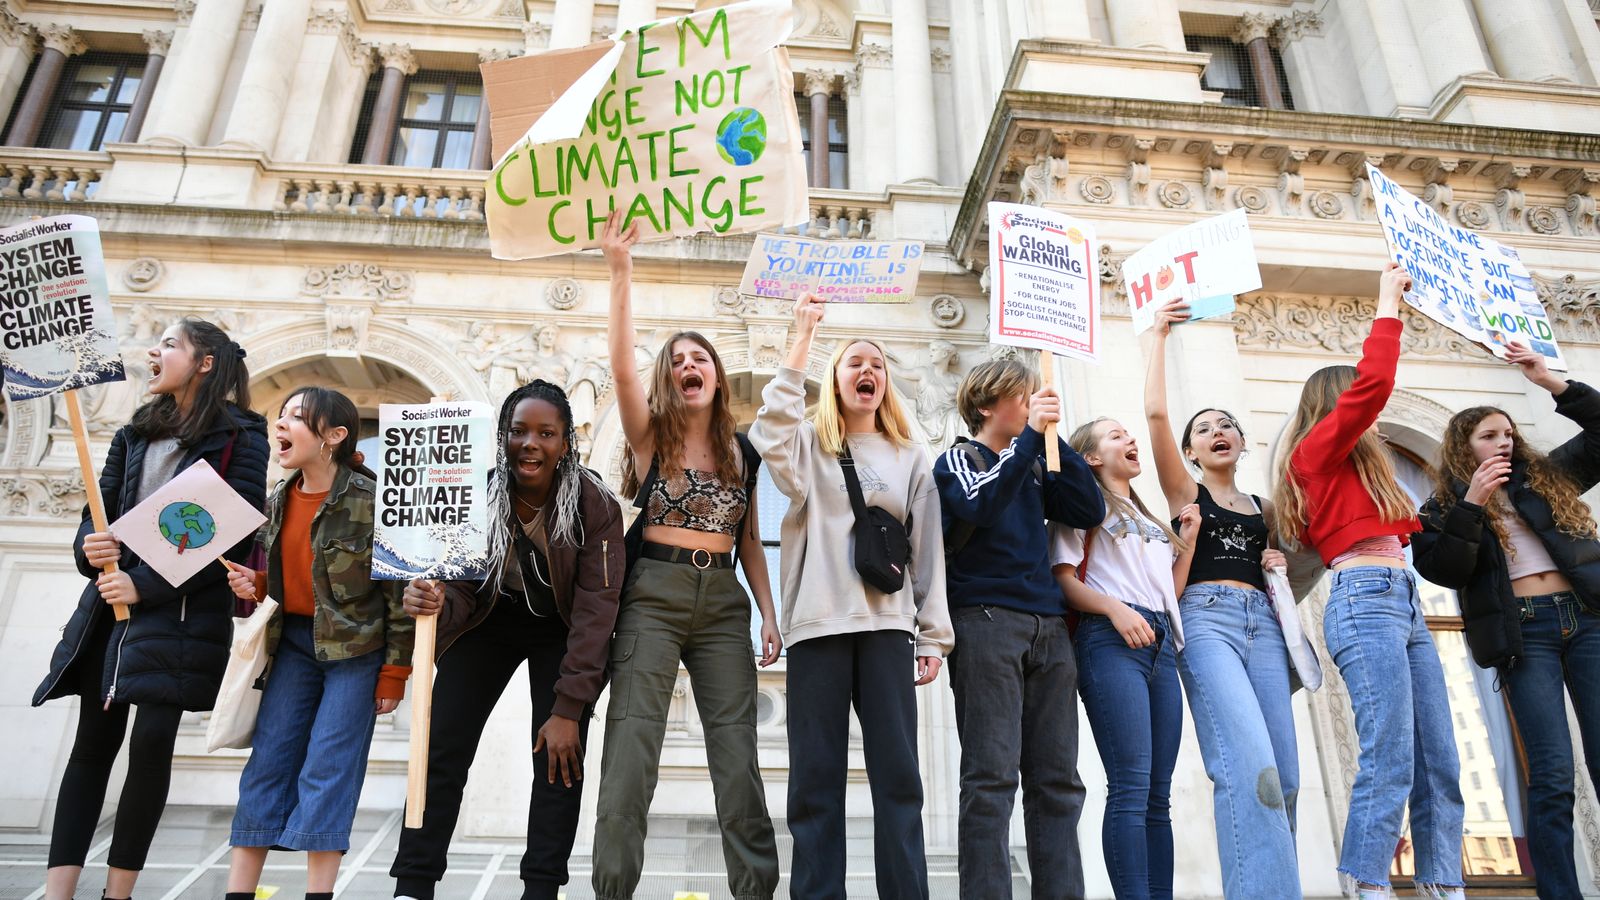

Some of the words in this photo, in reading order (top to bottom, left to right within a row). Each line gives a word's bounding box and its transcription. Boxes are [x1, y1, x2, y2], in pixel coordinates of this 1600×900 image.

[675, 64, 751, 116] NOT
[496, 123, 700, 205] CLIMATE
[548, 175, 766, 244] CHANGE
[1371, 170, 1405, 206] ONE
[1414, 200, 1445, 233] CAN
[0, 227, 36, 245] Socialist
[36, 221, 72, 236] Worker
[1010, 219, 1046, 231] Party
[1014, 213, 1064, 230] Socialist
[795, 241, 891, 259] TROUBLE
[903, 244, 921, 259] IS
[1019, 234, 1069, 258] Global
[1385, 203, 1397, 223] A
[1481, 257, 1510, 280] BUT
[888, 262, 906, 274] IS
[1003, 244, 1082, 274] WARNING
[1388, 226, 1455, 278] TOGETHER
[1484, 279, 1516, 302] CAN
[1032, 283, 1060, 294] ENERGY
[1131, 250, 1198, 310] HOT
[0, 286, 39, 312] NOT
[41, 284, 55, 293] One
[56, 278, 88, 289] solution:
[44, 287, 77, 300] revolution
[1034, 293, 1058, 305] GREEN
[1059, 299, 1077, 310] JOBS
[1397, 254, 1453, 305] CHANGE
[1450, 285, 1481, 317] THE
[1480, 305, 1553, 340] WORLD
[0, 294, 94, 331] CLIMATE
[1004, 308, 1025, 317] STOP
[1027, 311, 1058, 325] CLIMATE
[1059, 318, 1087, 333] CHANGE
[1007, 300, 1046, 313] SOCIALIST
[1047, 307, 1077, 322] CHANGE
[1078, 314, 1087, 324] TO
[4, 314, 94, 350] CHANGE
[402, 409, 438, 421] Socialist
[439, 407, 472, 419] Worker
[384, 424, 469, 446] SYSTEM
[384, 444, 472, 466] CHANGE
[384, 467, 426, 487] NOT
[382, 485, 472, 507] CLIMATE
[381, 506, 470, 527] CHANGE
